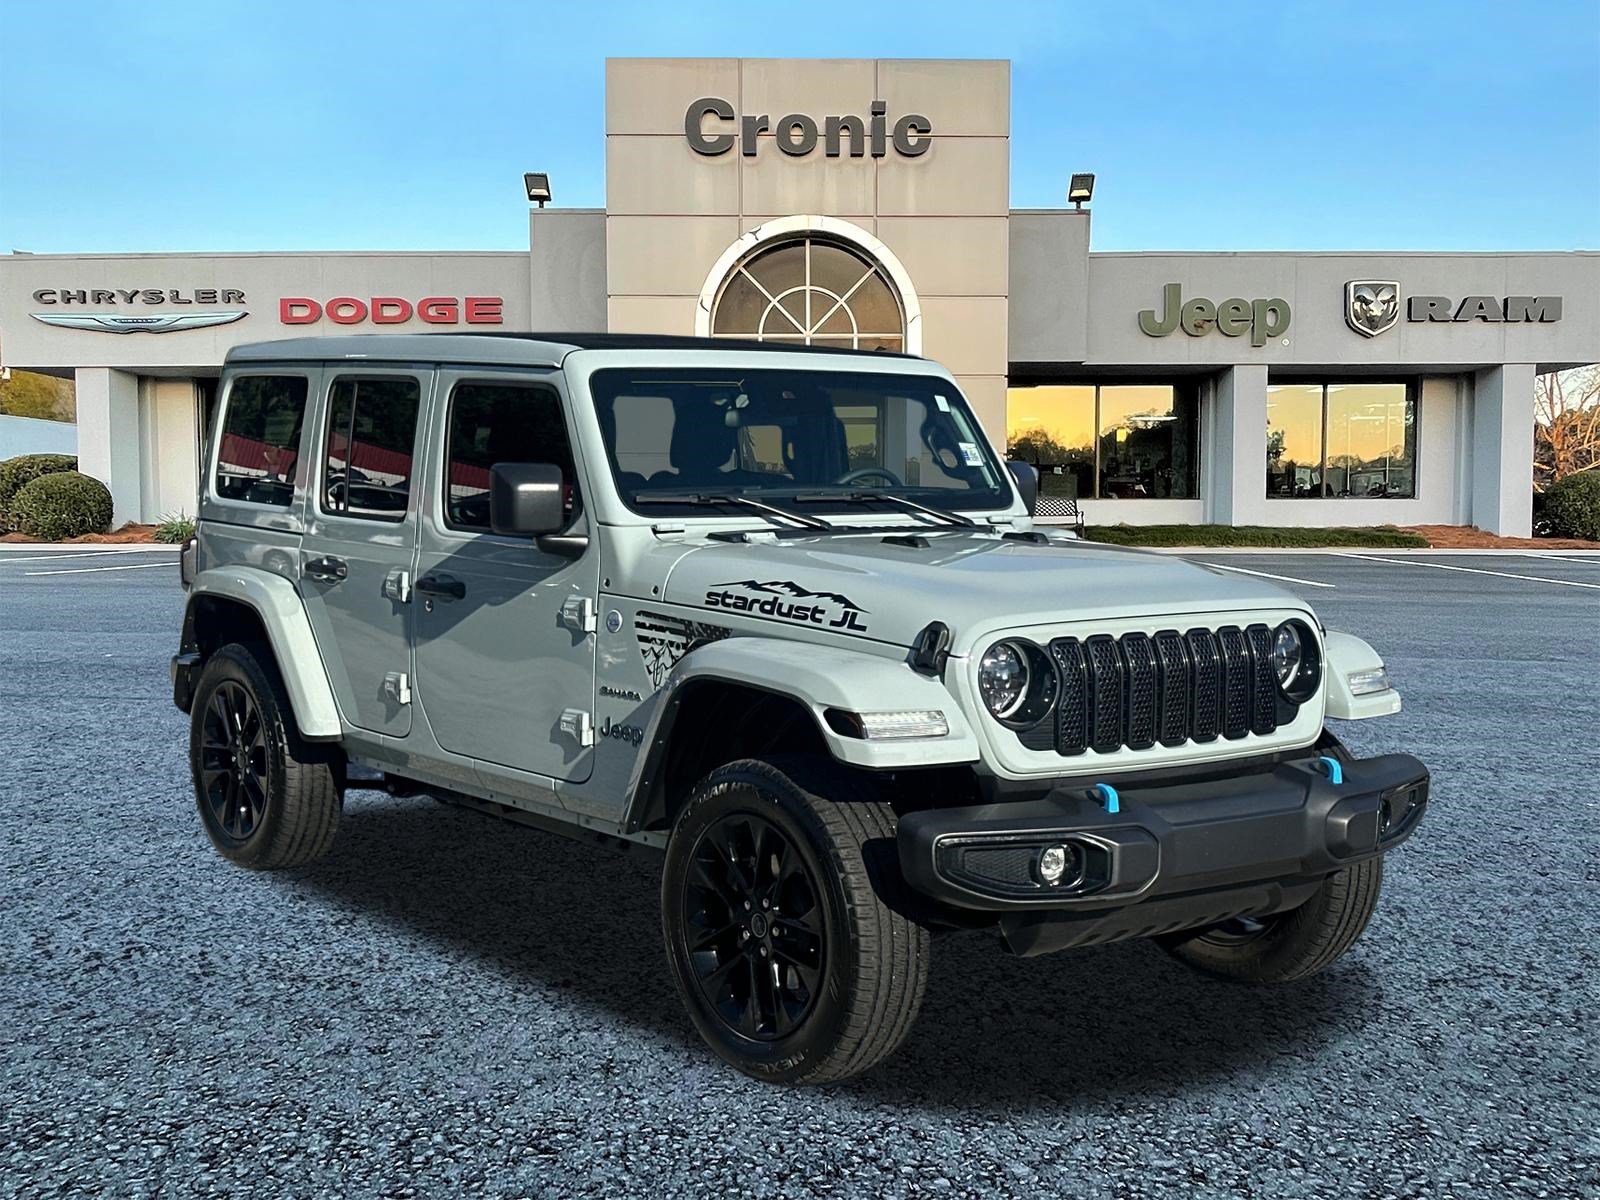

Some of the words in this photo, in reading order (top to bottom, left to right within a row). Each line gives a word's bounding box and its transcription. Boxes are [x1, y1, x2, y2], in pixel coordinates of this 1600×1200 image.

[685, 97, 932, 157] Cronic
[32, 289, 247, 305] CHRYSLER
[279, 297, 504, 325] DODGE
[1407, 296, 1563, 323] RAM
[1138, 283, 1291, 347] Jeep
[705, 590, 825, 623] stardust
[829, 609, 868, 633] JL
[600, 685, 643, 702] SAHARA
[600, 716, 644, 748] Jeep
